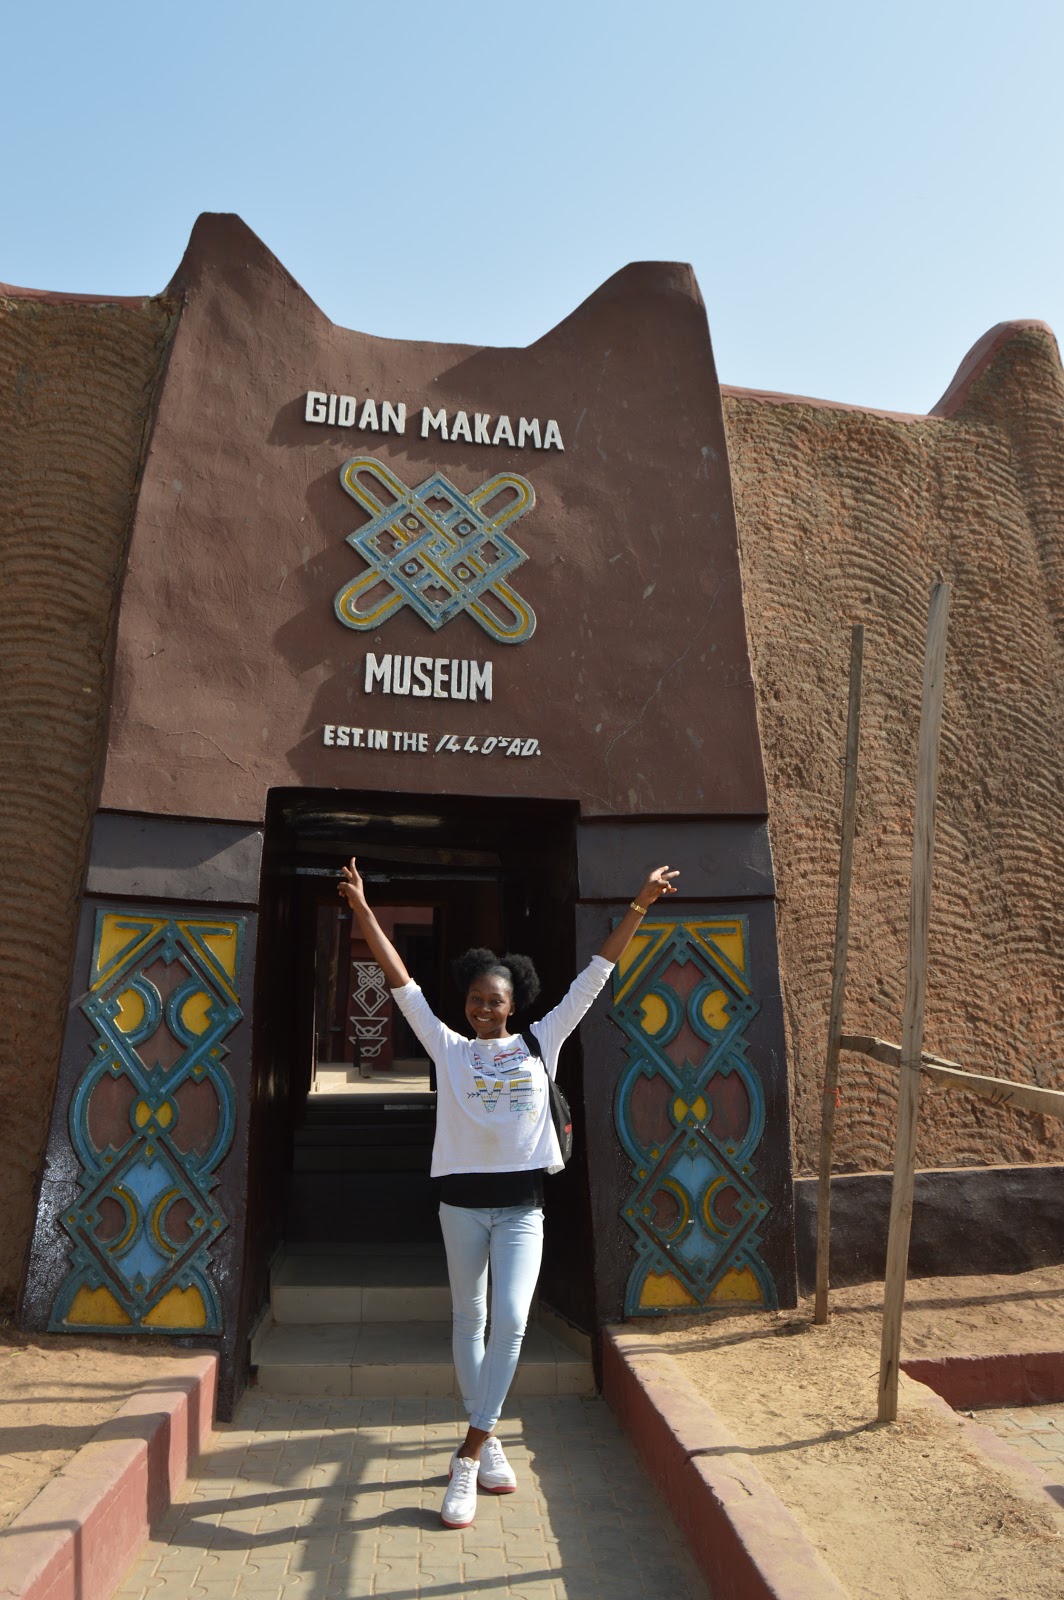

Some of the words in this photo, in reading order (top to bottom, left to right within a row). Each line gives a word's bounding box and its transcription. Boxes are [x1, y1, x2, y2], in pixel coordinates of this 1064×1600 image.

[305, 391, 407, 434] GIDAN
[421, 406, 565, 452] MAKAMA
[364, 652, 493, 701] MUSEUM
[393, 732, 428, 753] THE
